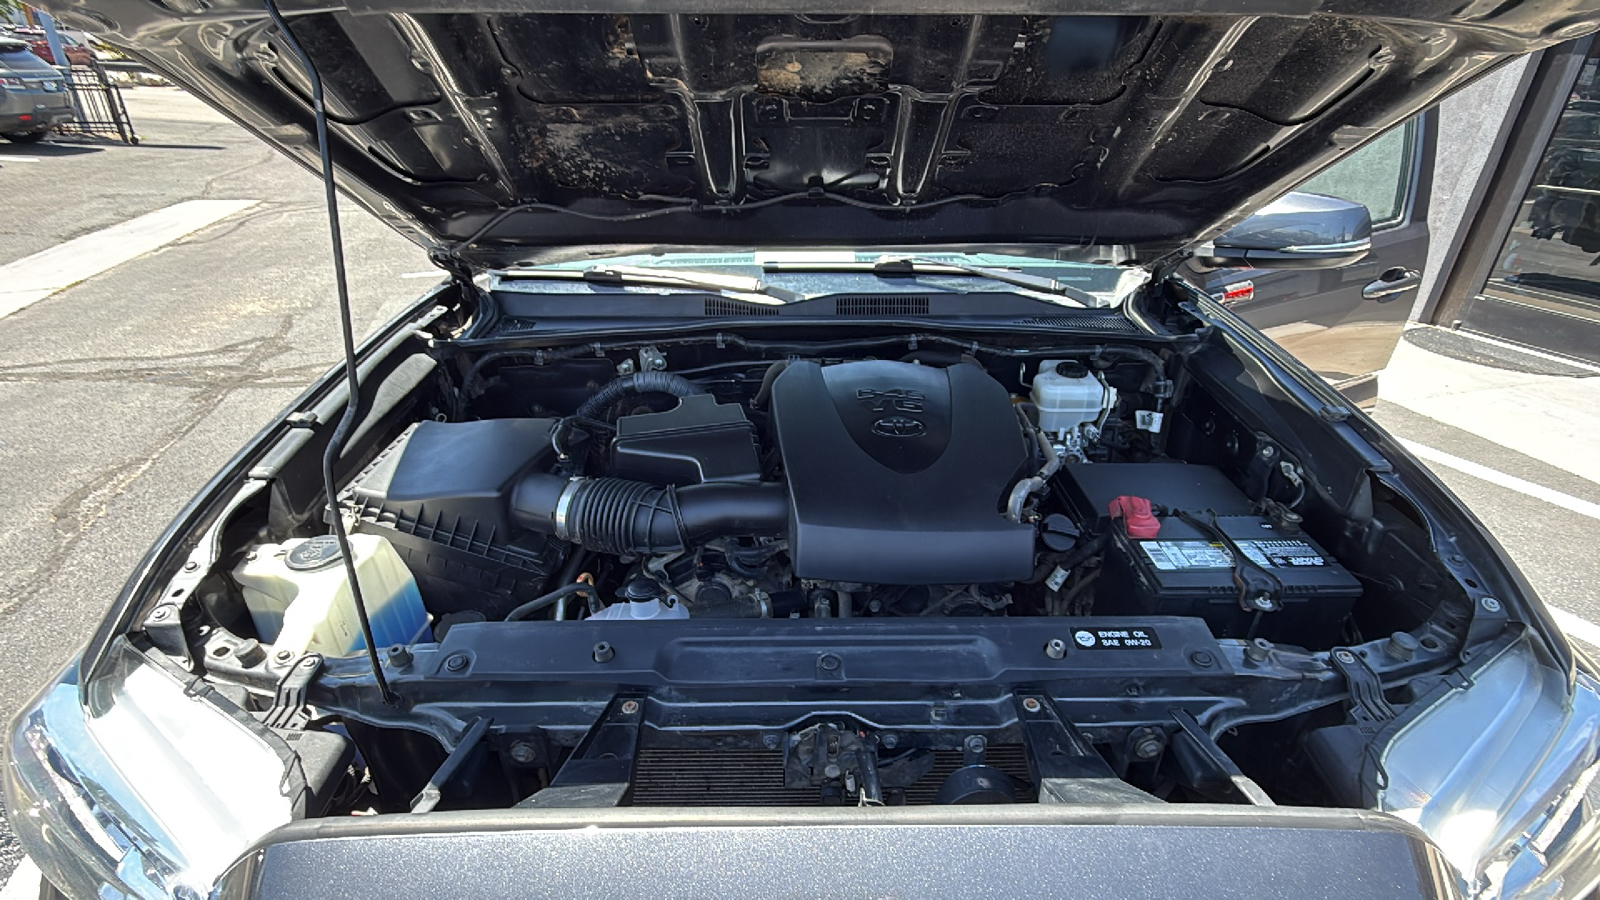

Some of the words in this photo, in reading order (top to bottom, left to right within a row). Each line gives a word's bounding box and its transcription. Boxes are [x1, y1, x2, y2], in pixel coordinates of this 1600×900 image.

[856, 388, 925, 413] V6
[1097, 630, 1130, 638] ENGINE
[1132, 630, 1149, 638] OIL
[1101, 639, 1120, 647] SAE
[1124, 639, 1152, 647] 0W-20
